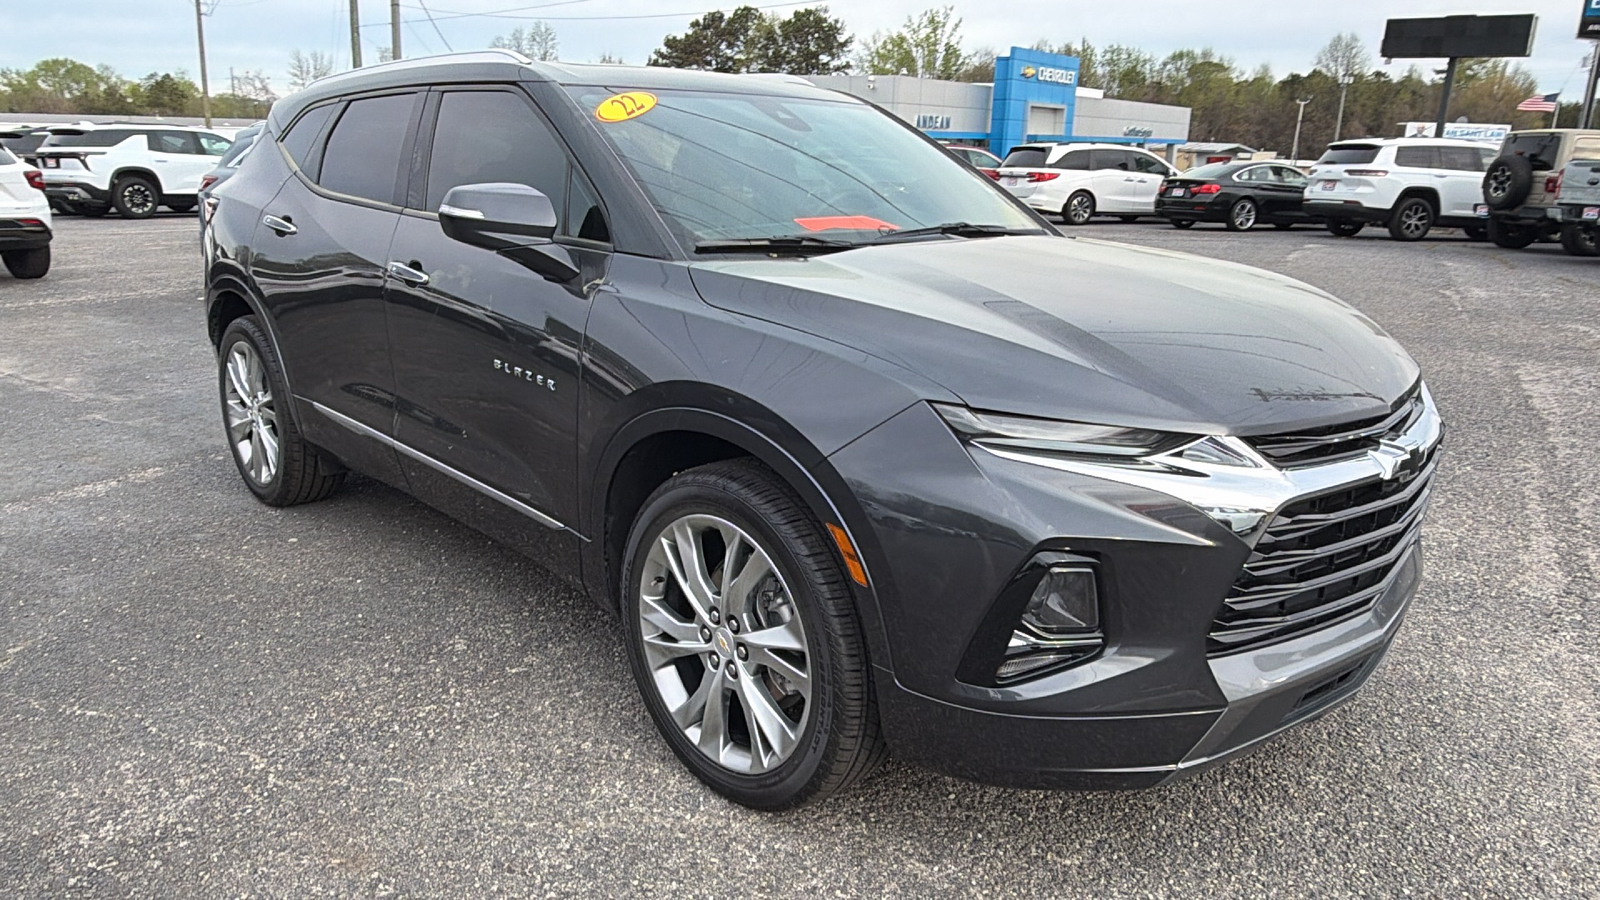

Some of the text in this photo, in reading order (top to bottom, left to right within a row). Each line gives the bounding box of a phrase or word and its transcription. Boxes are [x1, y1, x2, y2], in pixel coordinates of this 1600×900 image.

[1037, 66, 1076, 84] CHEVROLET
[610, 94, 646, 117] 22
[916, 114, 951, 129] ANDEAN
[493, 358, 556, 391] BLAZER
